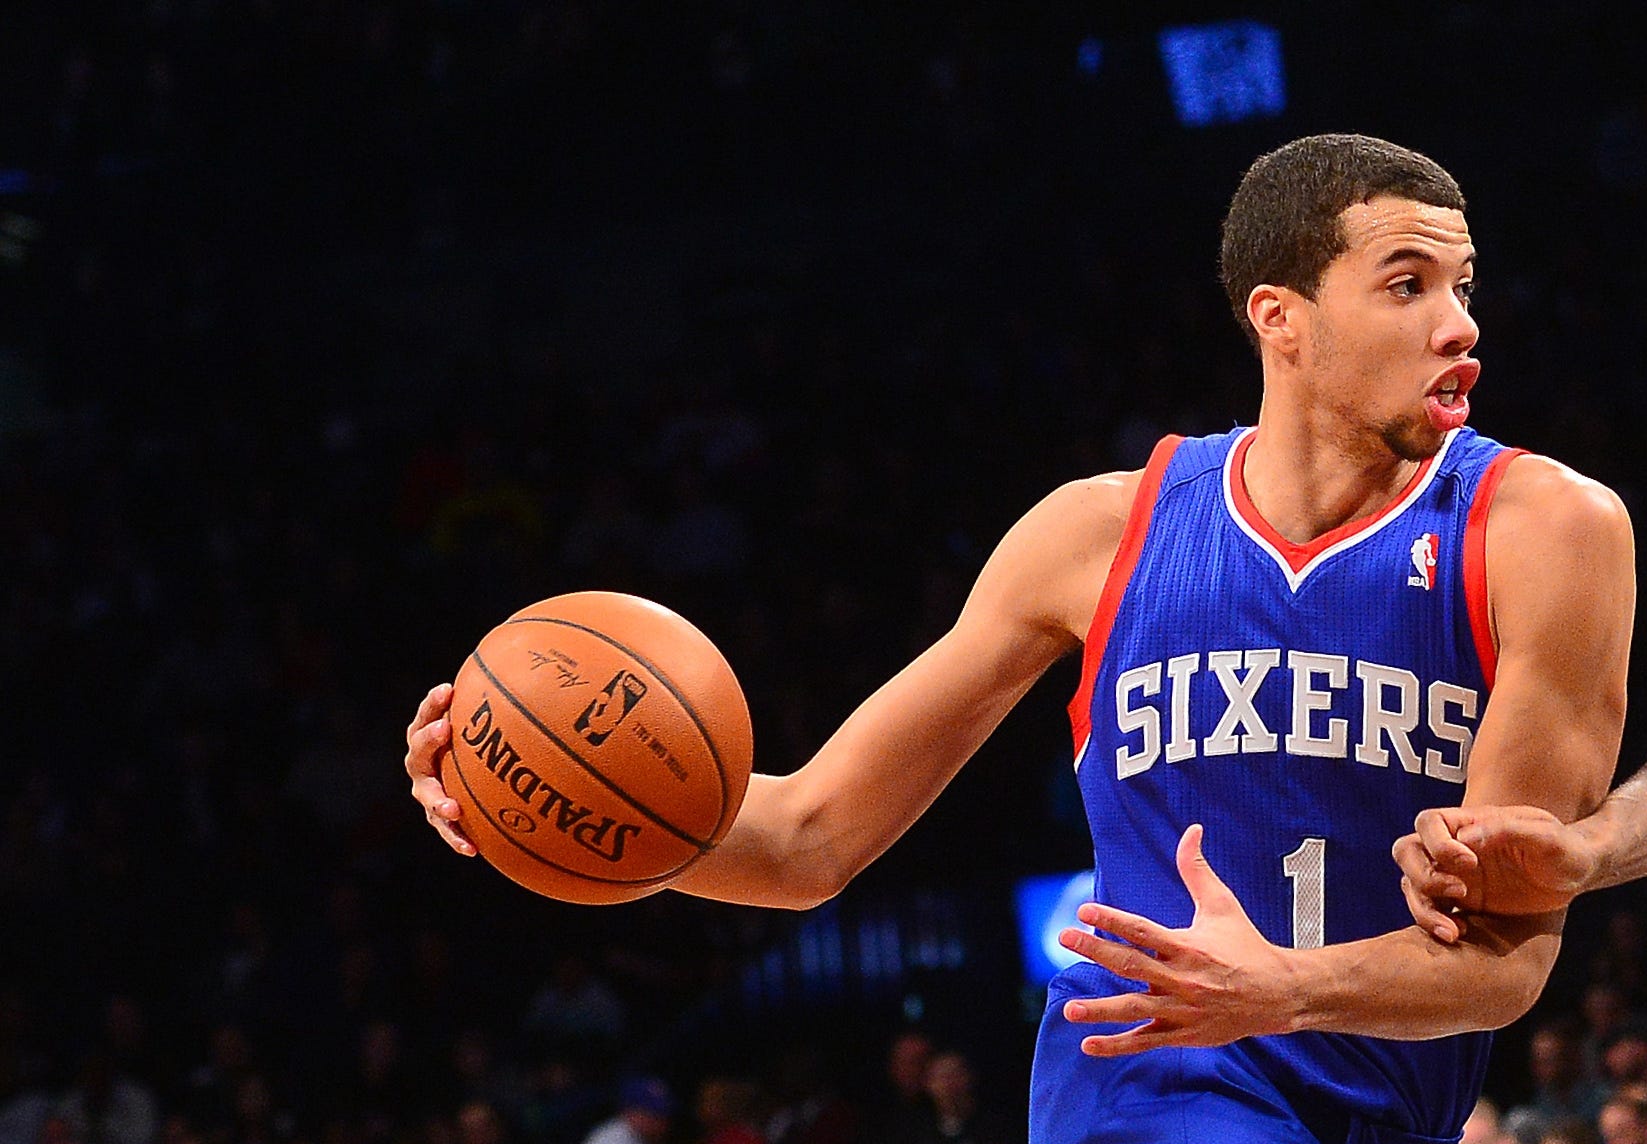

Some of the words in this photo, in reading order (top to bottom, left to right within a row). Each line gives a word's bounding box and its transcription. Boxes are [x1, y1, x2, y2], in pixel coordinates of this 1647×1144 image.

[462, 700, 642, 863] SPALDING
[1115, 648, 1479, 784] SIXERS
[1282, 837, 1326, 950] 1
